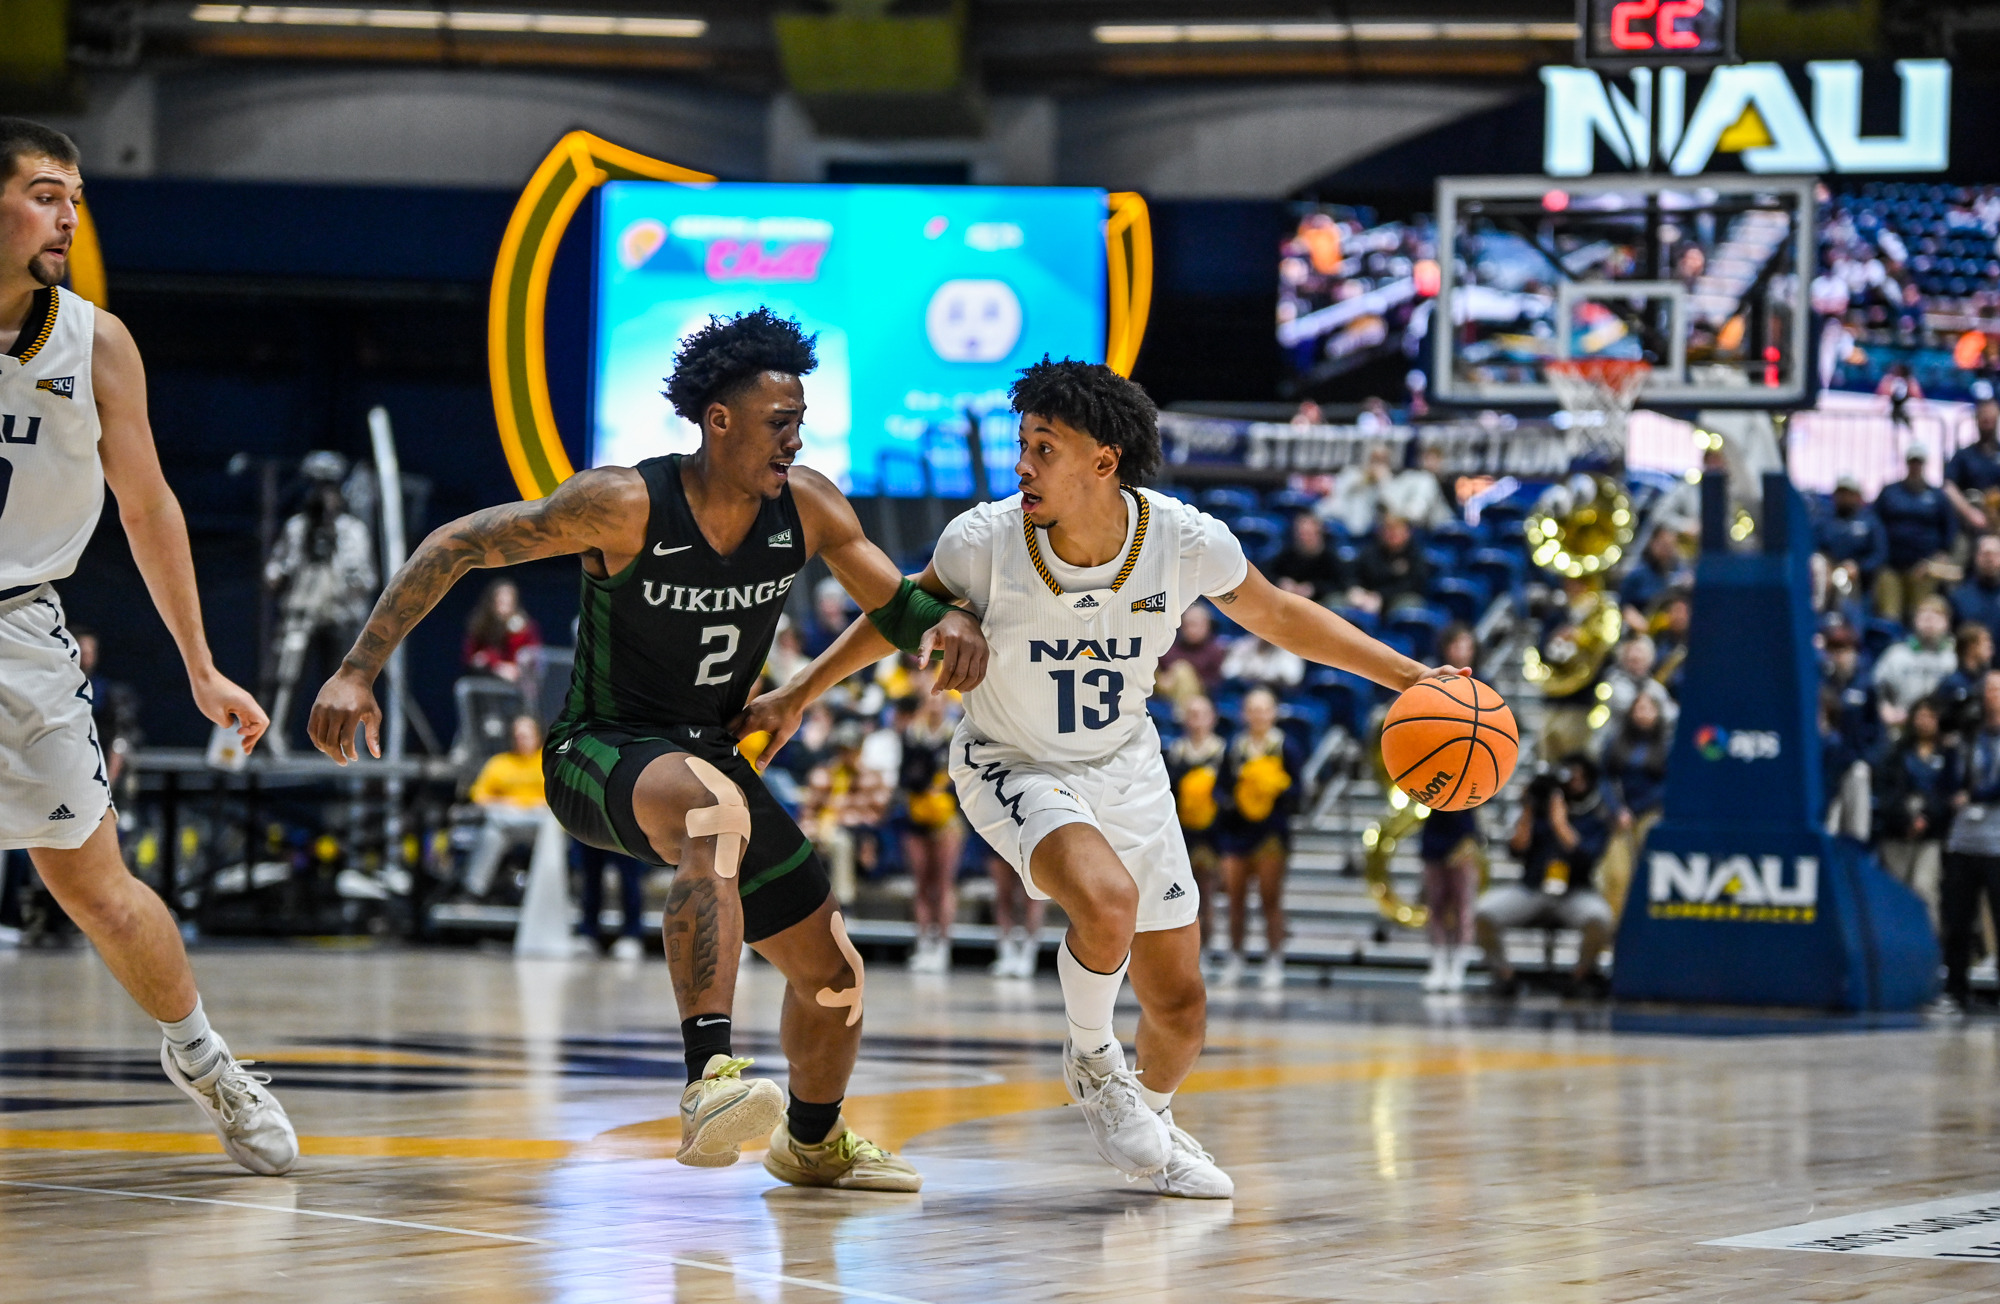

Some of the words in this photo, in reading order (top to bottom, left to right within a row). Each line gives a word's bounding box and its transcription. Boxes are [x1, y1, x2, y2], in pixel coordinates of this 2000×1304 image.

[1610, 0, 1706, 50] 22
[1538, 58, 1953, 177] NAU
[0, 414, 42, 445] U
[642, 573, 796, 612] VIKINGS
[1073, 601, 1099, 609] adidas
[694, 624, 741, 686] 2
[1028, 636, 1142, 662] NAU
[1048, 668, 1124, 734] 13
[1409, 770, 1454, 804] lson
[48, 813, 76, 821] adidas
[1163, 890, 1186, 901] adidas
[1650, 853, 1820, 906] NAU
